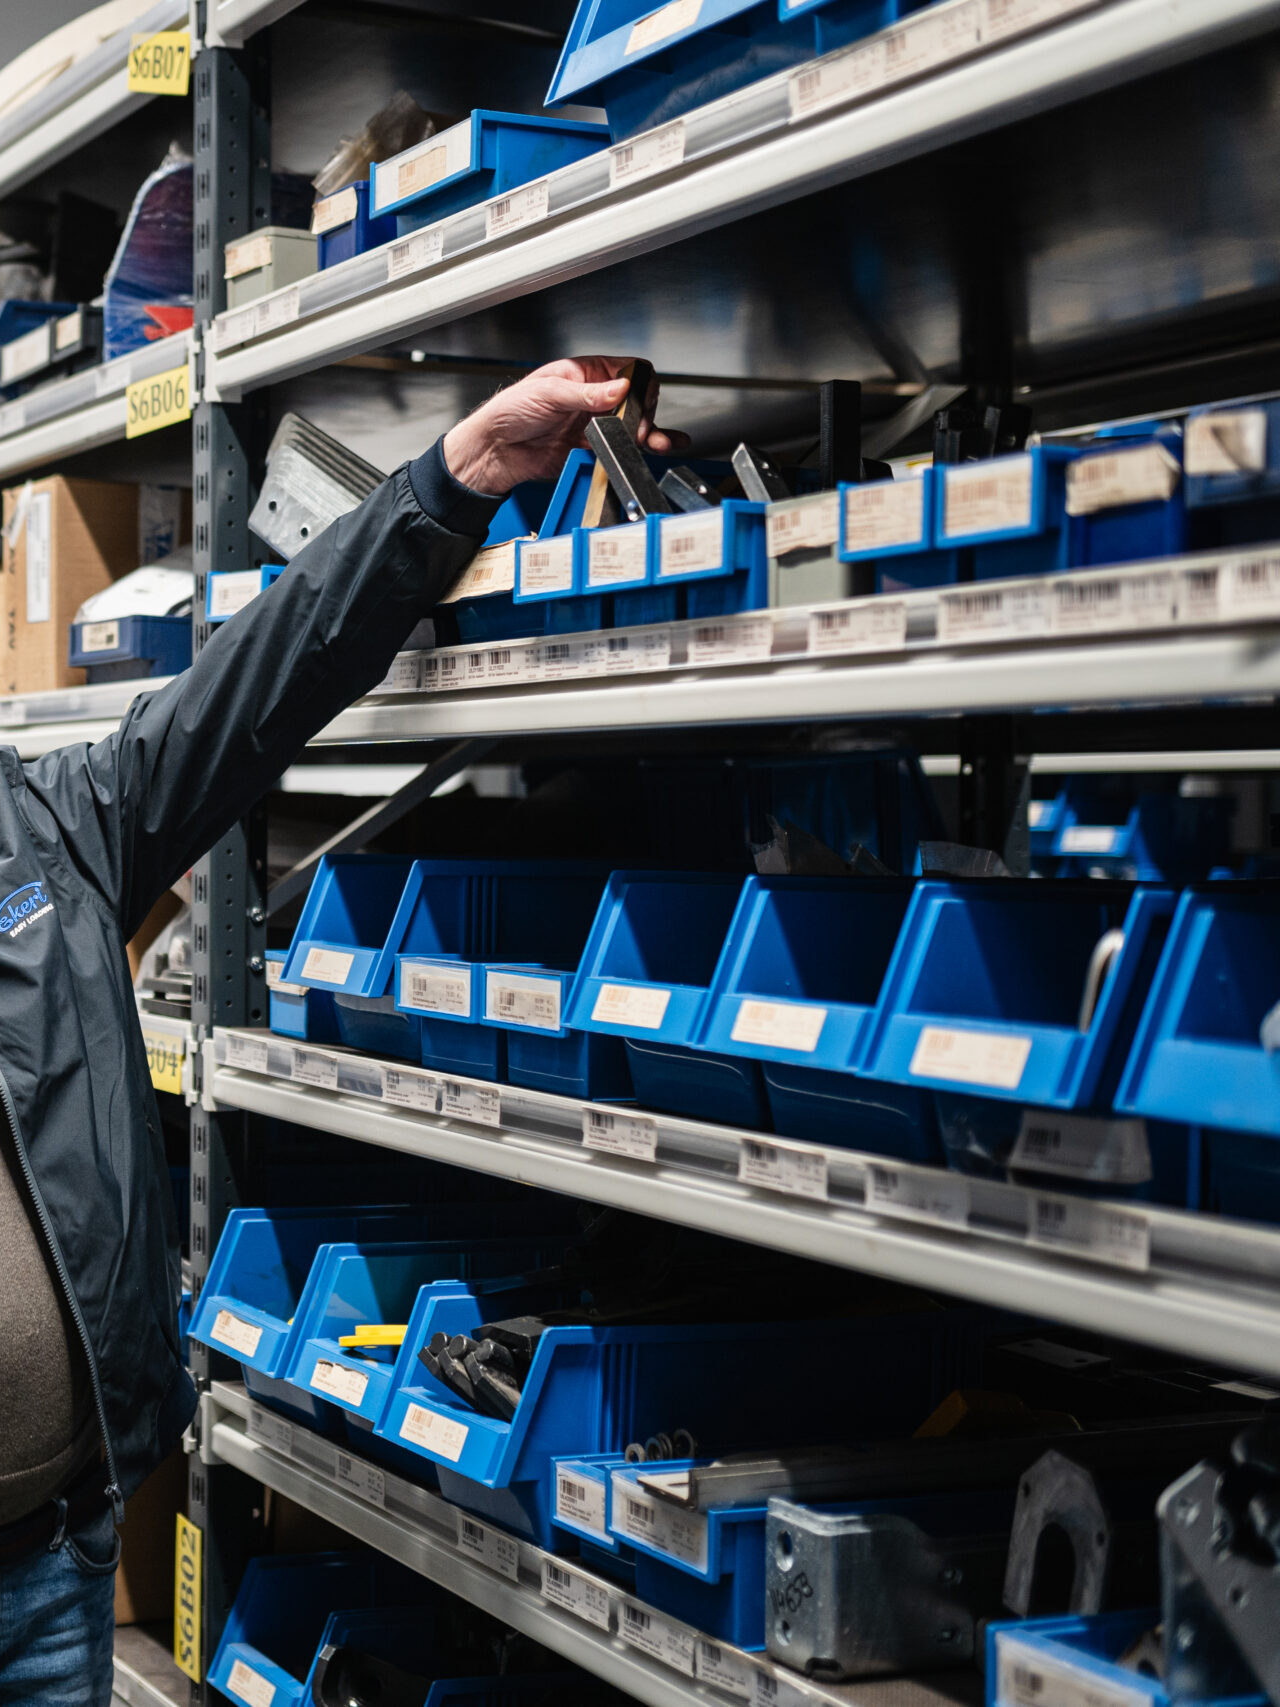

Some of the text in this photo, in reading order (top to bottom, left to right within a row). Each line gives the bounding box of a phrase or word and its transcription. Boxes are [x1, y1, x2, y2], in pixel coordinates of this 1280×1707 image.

[131, 45, 186, 80] S6B07
[129, 375, 186, 425] S6B06
[9, 903, 54, 938] EASY LOADING
[179, 1525, 196, 1671] S6B02
